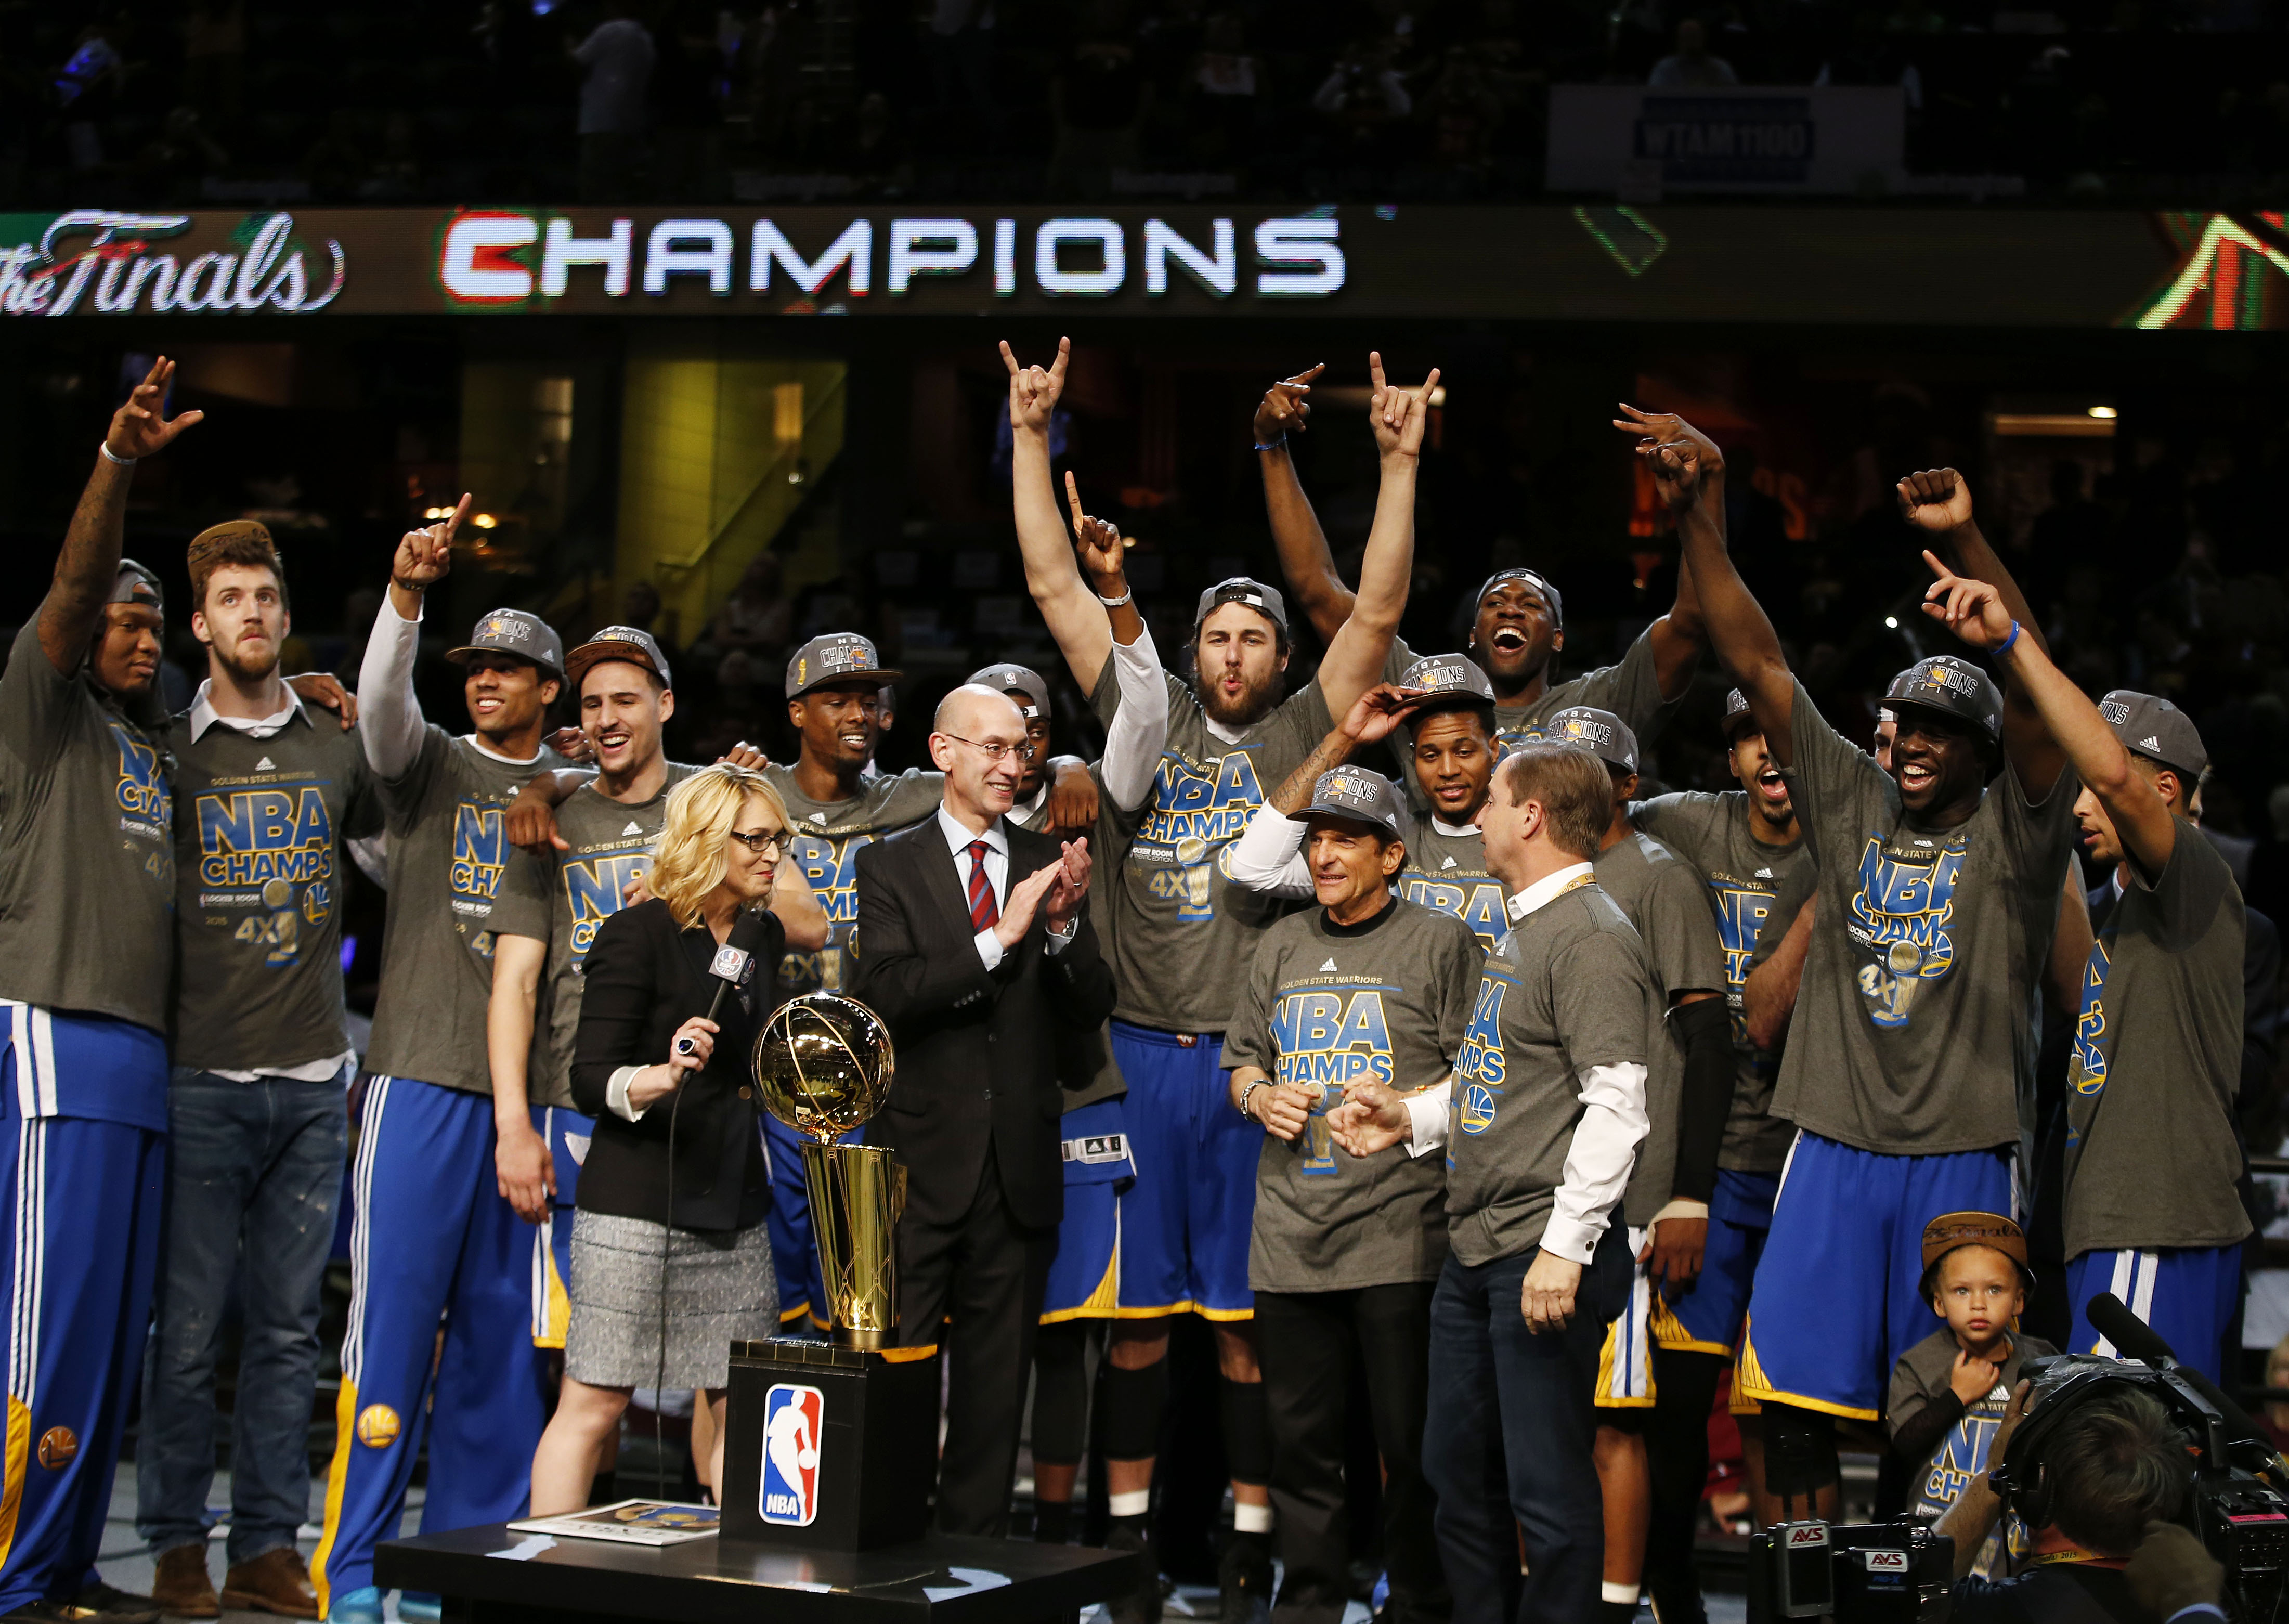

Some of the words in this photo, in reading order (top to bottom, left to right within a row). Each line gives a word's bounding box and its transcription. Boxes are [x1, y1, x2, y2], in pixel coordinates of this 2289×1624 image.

[40, 209, 345, 316] Finals
[441, 216, 1346, 297] CHAMPIONS
[1411, 659, 1441, 674] NBA
[1926, 657, 1959, 668] NBA
[1403, 666, 1466, 690] HAIONS
[1909, 664, 1978, 698] CHAIONS
[1560, 710, 1593, 719] NBA
[1549, 719, 1611, 745] HAIONS
[2139, 740, 2161, 753] adidas
[1196, 764, 1216, 774] STAT
[1328, 766, 1360, 776] NBA
[1155, 751, 1265, 814] NBA
[1316, 775, 1378, 802] HAIONS
[196, 787, 332, 855] NBA
[578, 842, 615, 854] GOLDEN
[615, 838, 643, 849] STATE
[1132, 847, 1151, 855] OCKER
[1151, 848, 1174, 858] ROOM
[1903, 850, 1933, 859] STATE
[200, 848, 332, 886] CHAMPS
[790, 832, 875, 892] BA
[1456, 869, 1490, 878] WARRIO
[1148, 869, 1190, 899] 4X
[1711, 872, 1745, 887] GOLDEN
[1858, 838, 1967, 917] NBA
[235, 916, 279, 945] 4X
[1714, 889, 1777, 954] NB
[1852, 891, 1954, 947] CHAM
[1280, 977, 1309, 990] GOLDEN
[1310, 976, 1335, 985] STATE
[1336, 975, 1383, 985] WARRIORS
[1857, 963, 1897, 1008] 4X
[1269, 991, 1394, 1056] NBA
[1464, 977, 1508, 1051] BA
[1275, 1051, 1395, 1086] HAMPS
[1456, 1040, 1506, 1086] MPS
[1987, 1403, 2008, 1412] TATE
[766, 1493, 798, 1516] NBA
[1790, 1527, 1824, 1543] AVS
[1870, 1553, 1902, 1565] AVS
